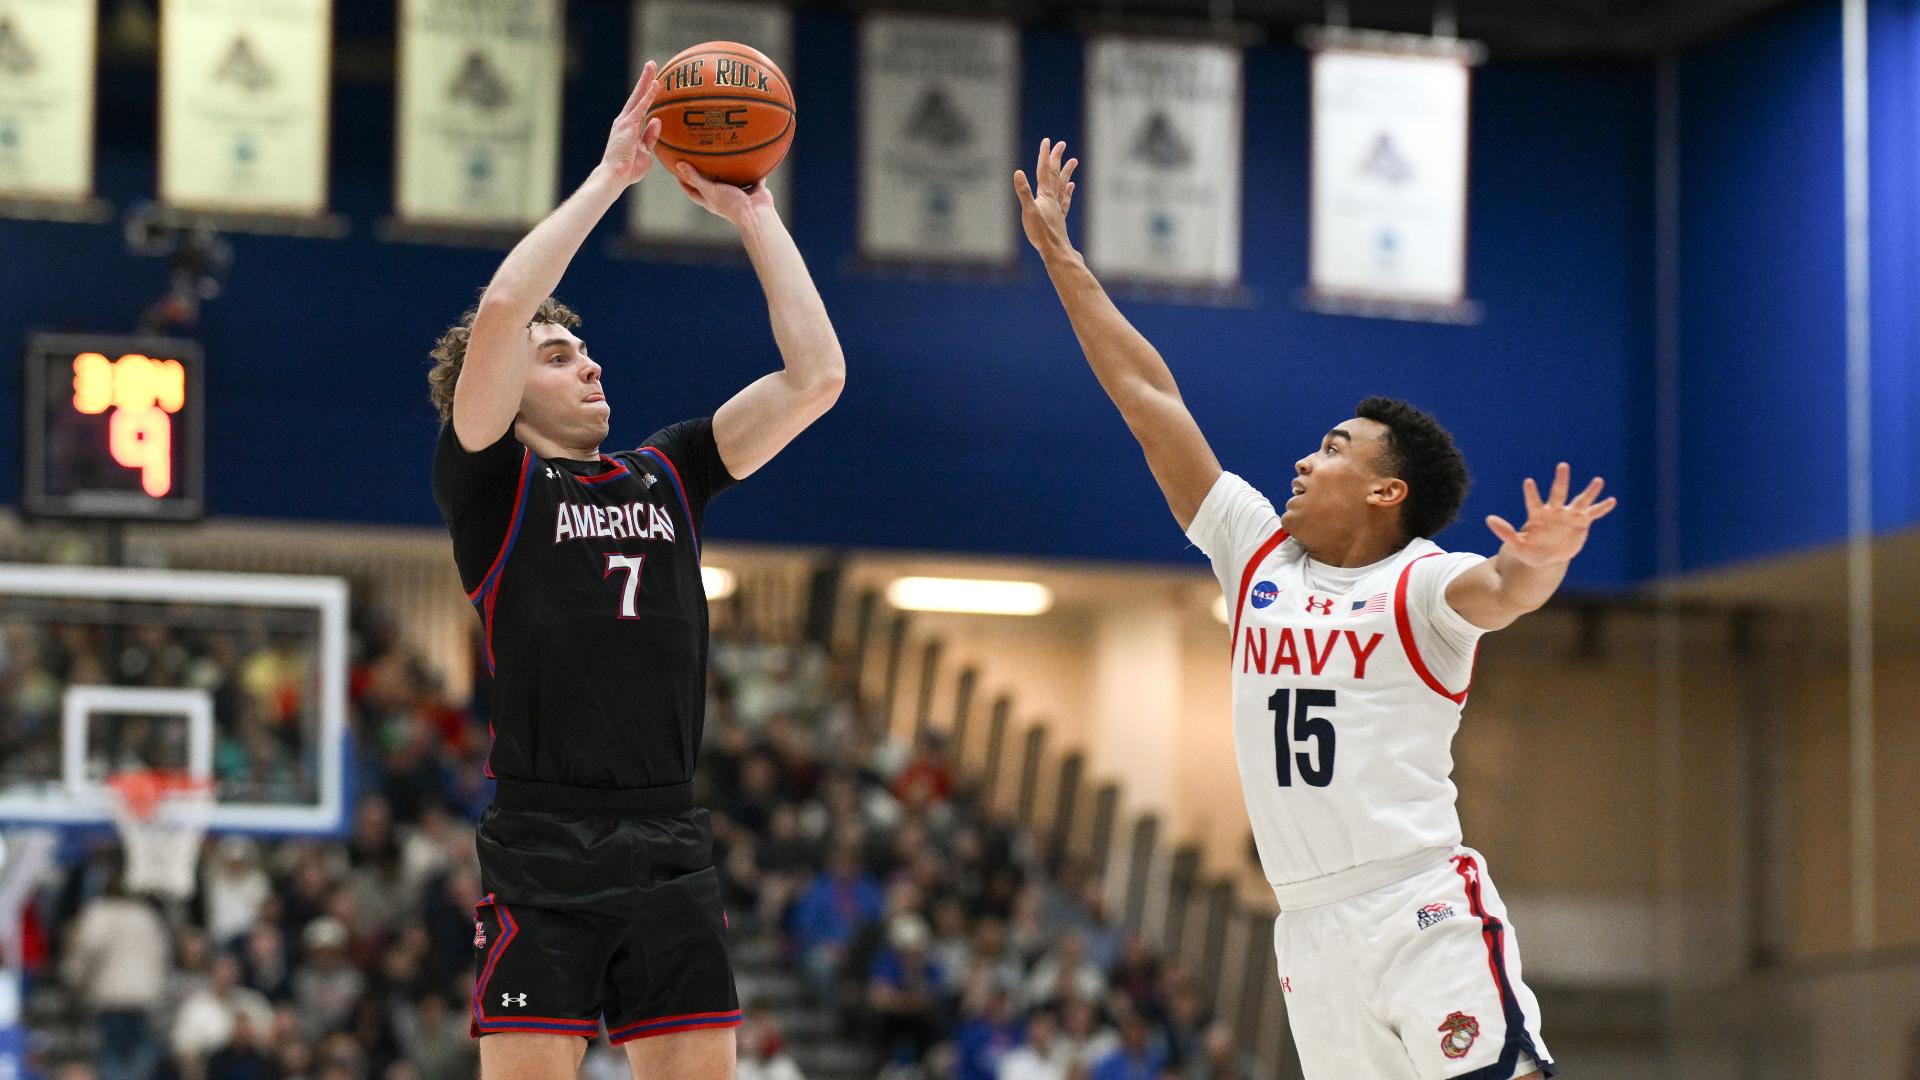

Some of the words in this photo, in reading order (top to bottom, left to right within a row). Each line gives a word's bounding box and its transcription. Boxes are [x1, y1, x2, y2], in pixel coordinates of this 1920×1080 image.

[664, 59, 704, 92] THE
[715, 58, 769, 92] ROCK
[683, 109, 748, 127] C2C
[109, 407, 172, 497] 9
[554, 501, 677, 544] AMERICAN
[602, 552, 647, 621] 7
[1253, 589, 1276, 601] NASA
[1243, 626, 1385, 680] NAVY
[1268, 688, 1337, 788] 15
